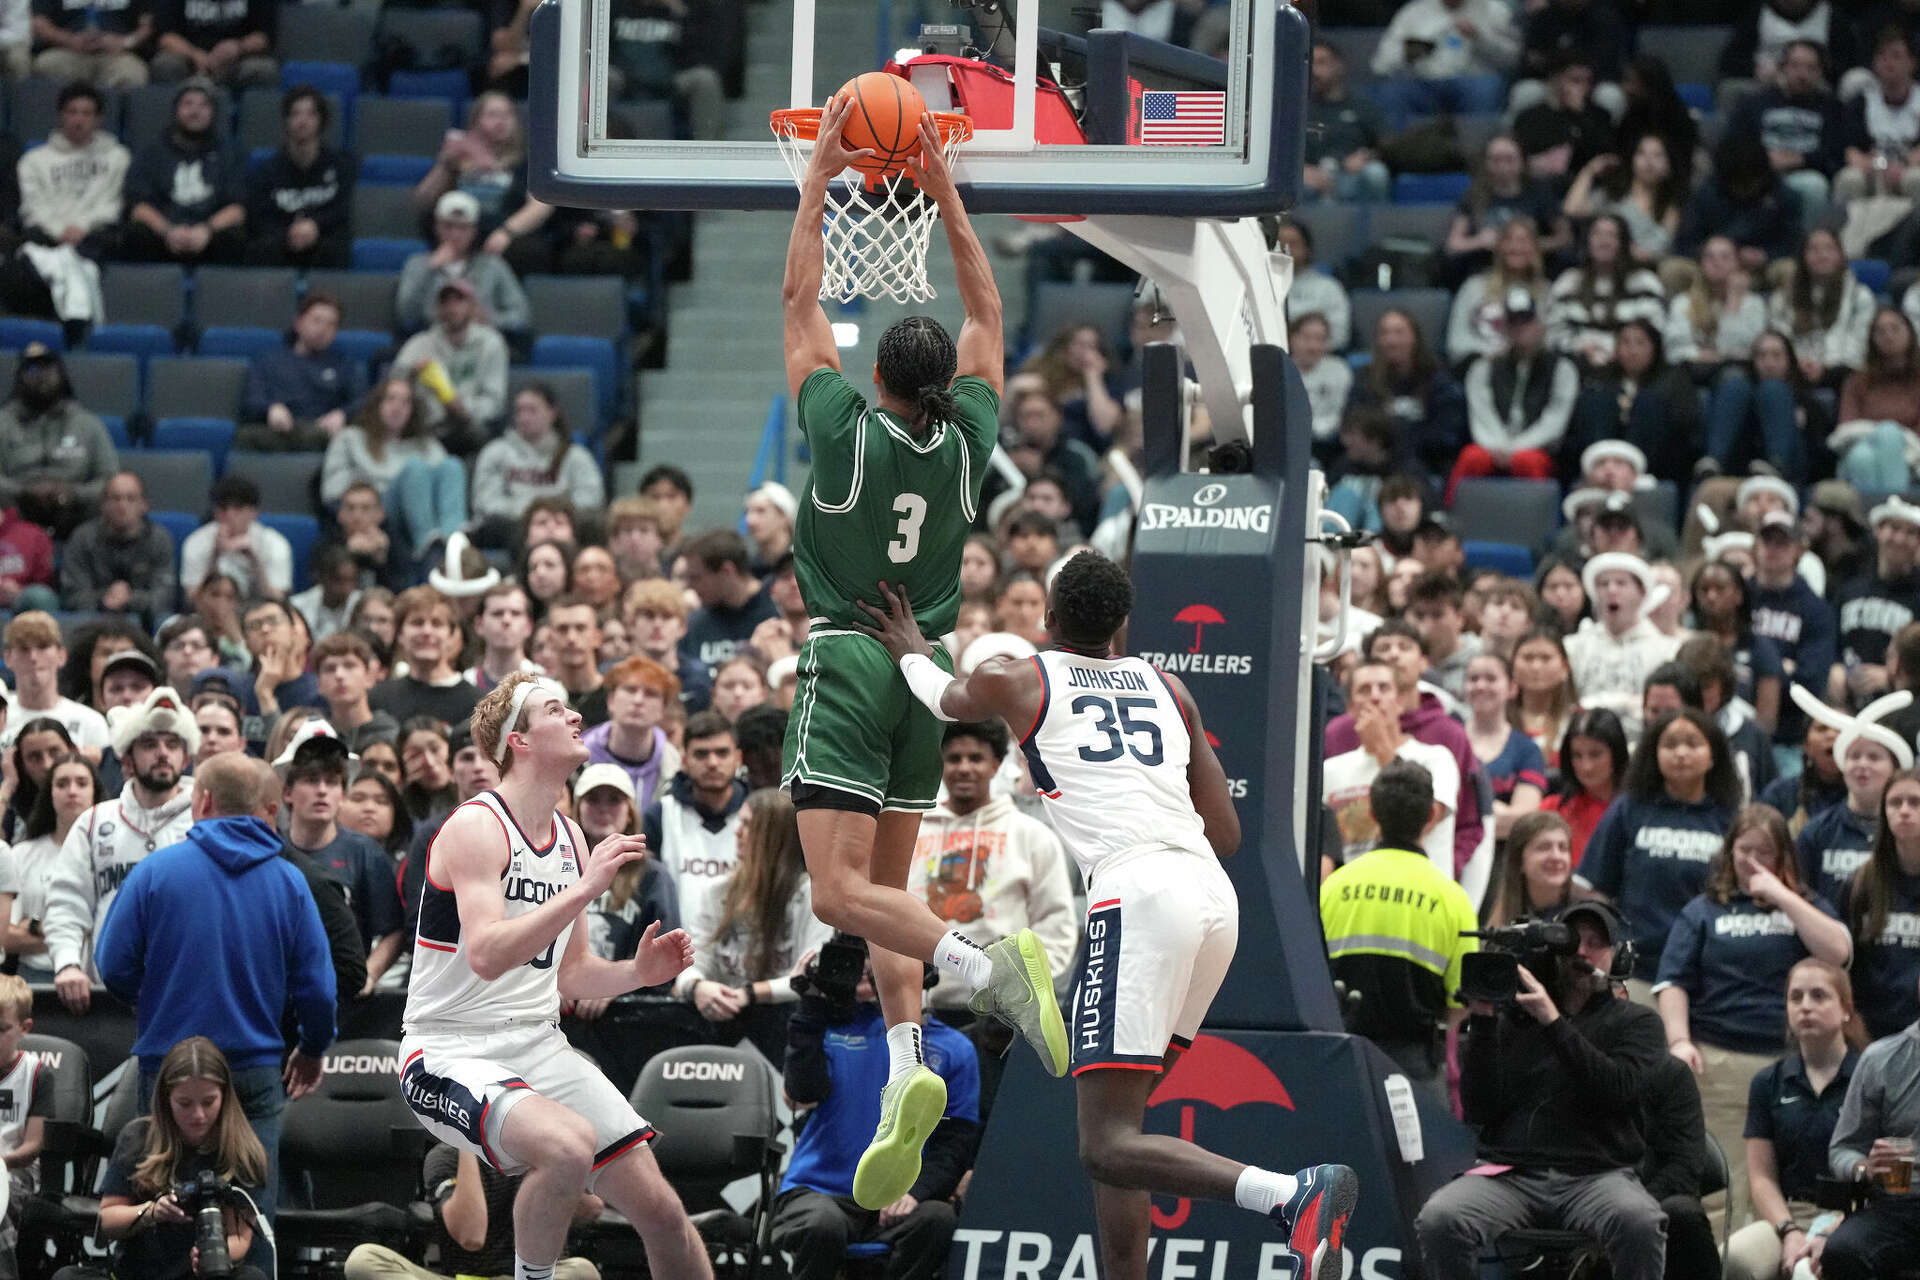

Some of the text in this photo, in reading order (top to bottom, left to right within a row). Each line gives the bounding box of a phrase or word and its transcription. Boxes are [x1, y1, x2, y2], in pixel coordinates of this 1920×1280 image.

[888, 493, 928, 563] 3
[1141, 503, 1271, 533] SPALDING
[1139, 653, 1253, 674] TRAVELERS
[1069, 666, 1149, 691] JOHNSON
[1072, 696, 1164, 766] 35
[504, 877, 568, 905] UCON
[1342, 884, 1439, 912] SECURITY
[1082, 919, 1107, 1050] HUSKIES
[322, 1056, 400, 1074] UCONN
[662, 1062, 744, 1081] UCONN
[953, 1229, 1402, 1280] TRAELES
